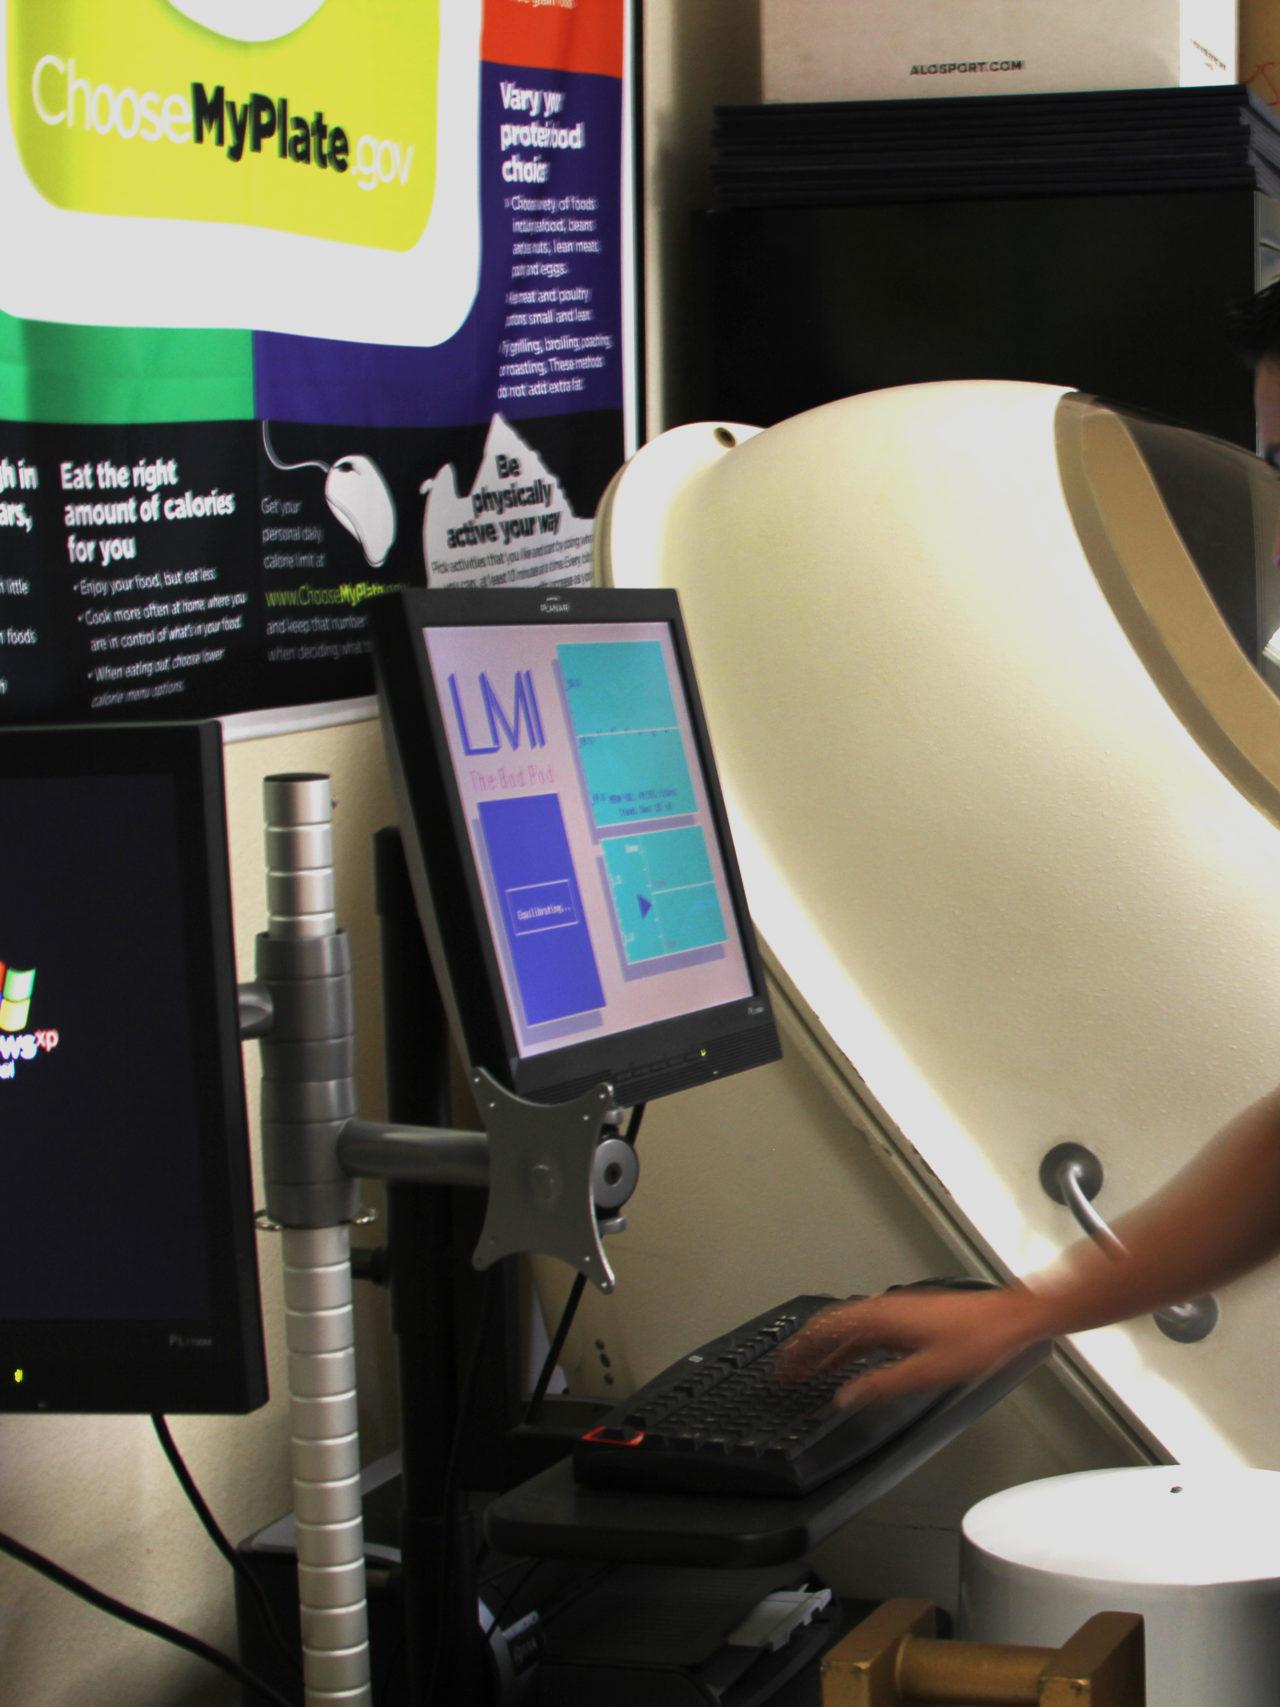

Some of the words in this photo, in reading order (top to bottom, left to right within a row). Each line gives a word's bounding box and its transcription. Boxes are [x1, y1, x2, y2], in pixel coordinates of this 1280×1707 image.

[500, 81, 541, 117] Vary
[529, 308, 554, 325] small
[18, 458, 39, 490] in
[60, 461, 94, 491] Eat
[96, 459, 131, 490] the
[132, 458, 179, 492] right
[495, 453, 522, 478] Be
[64, 497, 137, 527] amount
[140, 493, 160, 523] of
[163, 488, 236, 520] calories
[261, 495, 281, 515] Get
[471, 479, 554, 518] physically
[446, 520, 499, 549] active
[499, 515, 537, 545] your
[538, 511, 562, 535] way
[67, 533, 96, 563] for
[99, 537, 137, 567] you
[6, 577, 30, 595] little
[80, 578, 109, 596] Enjoy
[109, 577, 136, 596] your
[163, 570, 183, 587] but
[85, 608, 112, 626] Cook
[113, 606, 142, 622] more
[143, 600, 169, 619] often
[171, 600, 181, 616] at
[7, 625, 38, 645] foods
[91, 635, 108, 652] are
[109, 633, 119, 649] in
[120, 628, 155, 649] control
[156, 625, 170, 643] of
[95, 665, 123, 682] When
[125, 660, 153, 677] eating
[448, 668, 546, 757] LMI
[34, 1029, 59, 1053] xp
